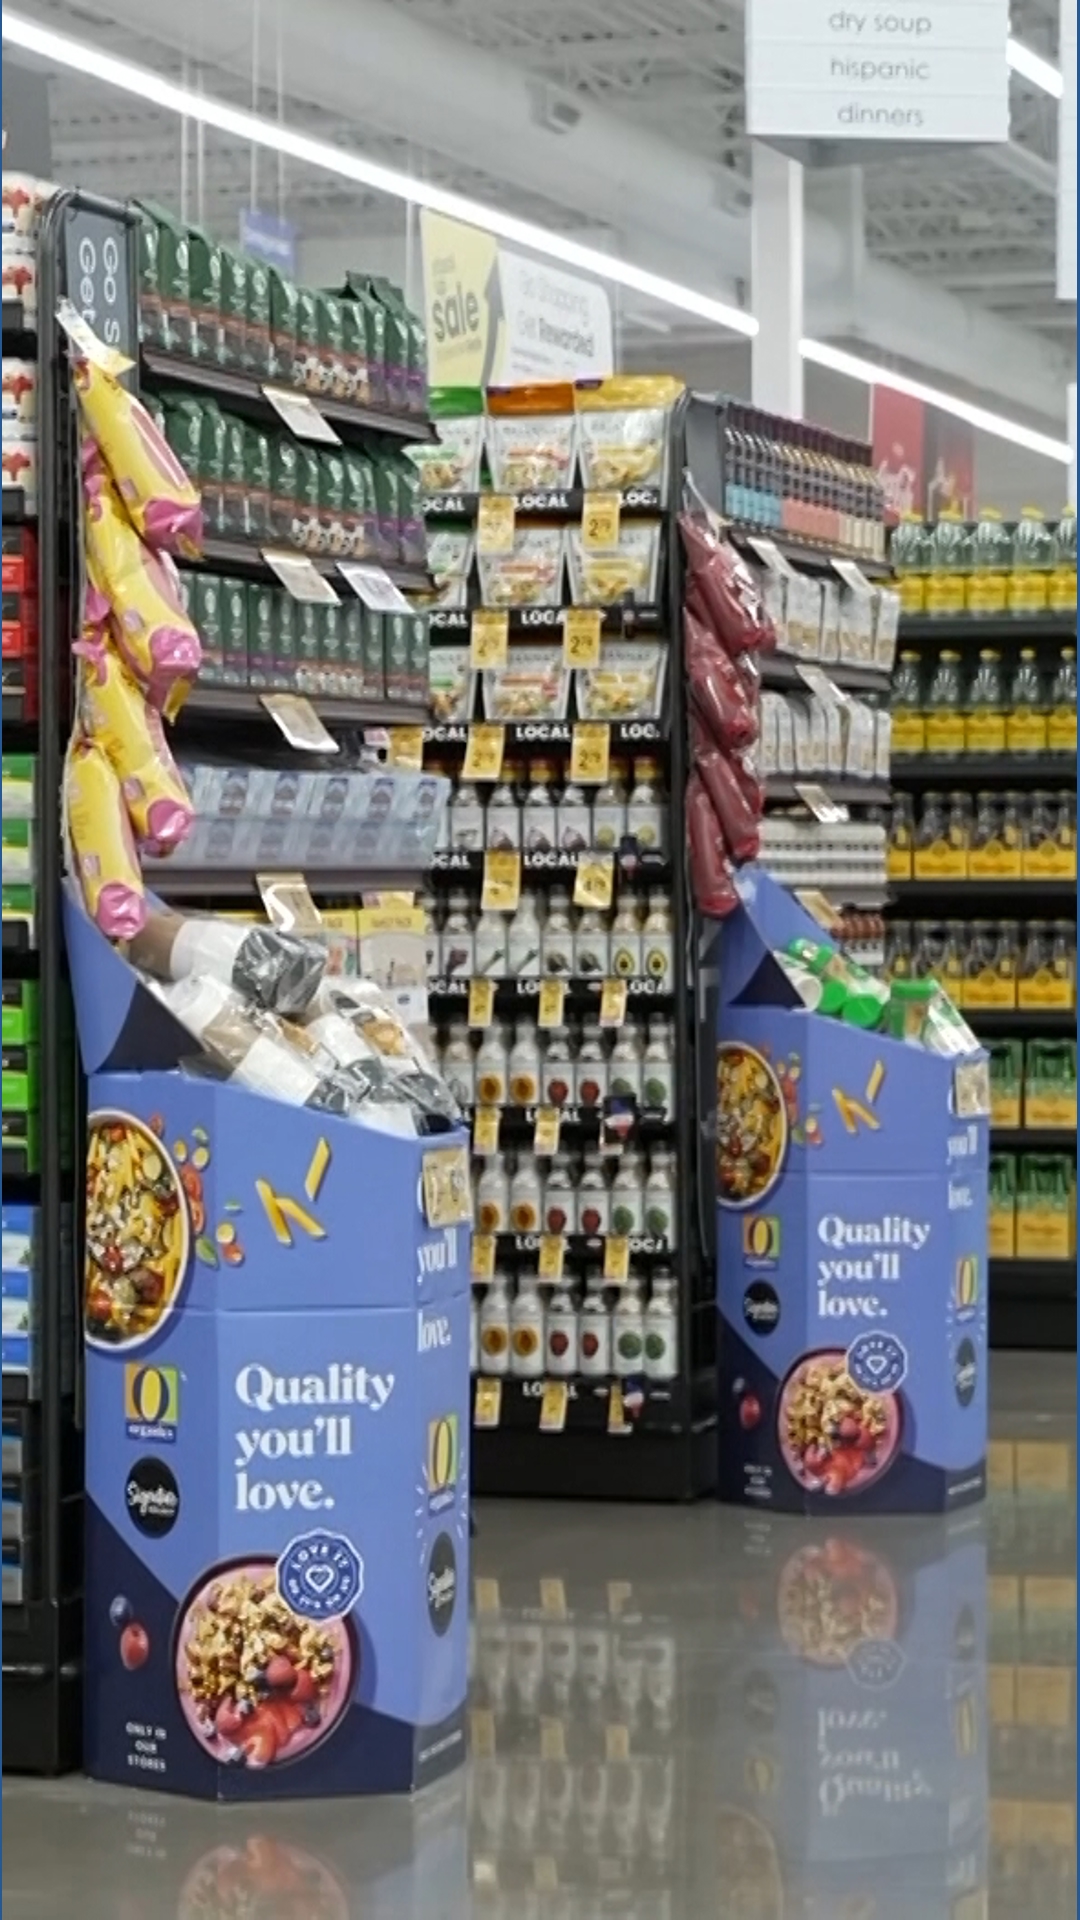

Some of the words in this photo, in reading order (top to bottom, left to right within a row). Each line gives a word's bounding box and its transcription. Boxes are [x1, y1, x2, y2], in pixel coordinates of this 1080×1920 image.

[828, 11, 867, 33] dry
[874, 13, 932, 35] soup
[830, 57, 930, 82] hispanic
[837, 102, 925, 127] dinners
[103, 236, 119, 305] Go
[432, 281, 480, 344] sale
[104, 318, 120, 344] S
[515, 723, 571, 741] LOCAL
[816, 1213, 932, 1251] Quality
[816, 1252, 901, 1288] you'll
[816, 1289, 889, 1319] love.
[234, 1362, 396, 1412] Quality
[234, 1415, 353, 1468] you'll
[234, 1471, 336, 1512] love.
